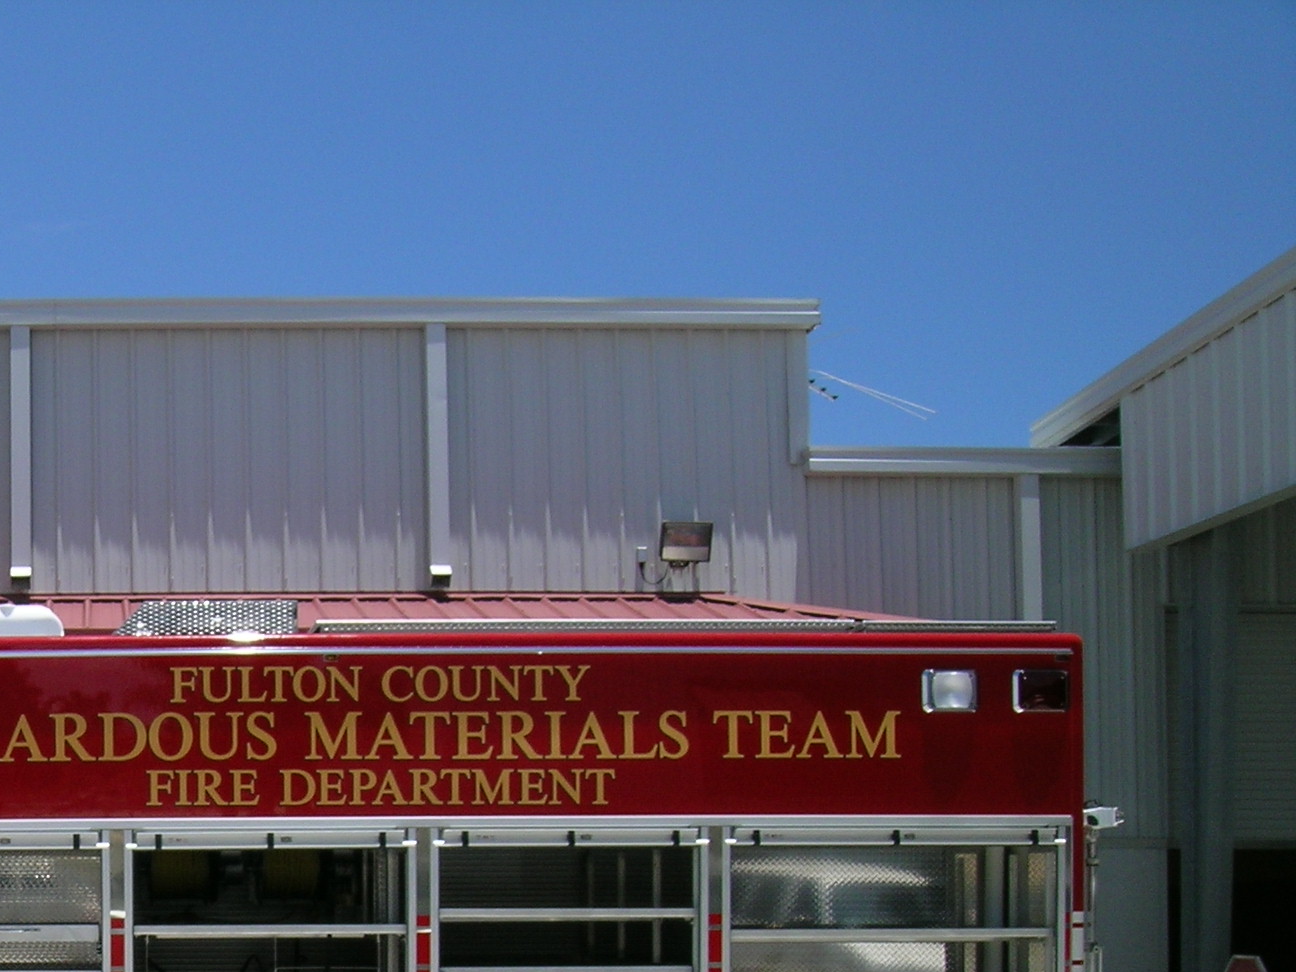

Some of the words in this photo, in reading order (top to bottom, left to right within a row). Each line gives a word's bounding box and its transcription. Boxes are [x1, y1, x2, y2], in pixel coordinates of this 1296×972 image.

[169, 665, 363, 703] FULTON
[381, 664, 591, 702] COUNTY
[304, 709, 691, 761] MATERIALS
[712, 709, 902, 759] TEAM
[145, 769, 260, 807] FIRE
[279, 768, 616, 806] DEPARTMENT
